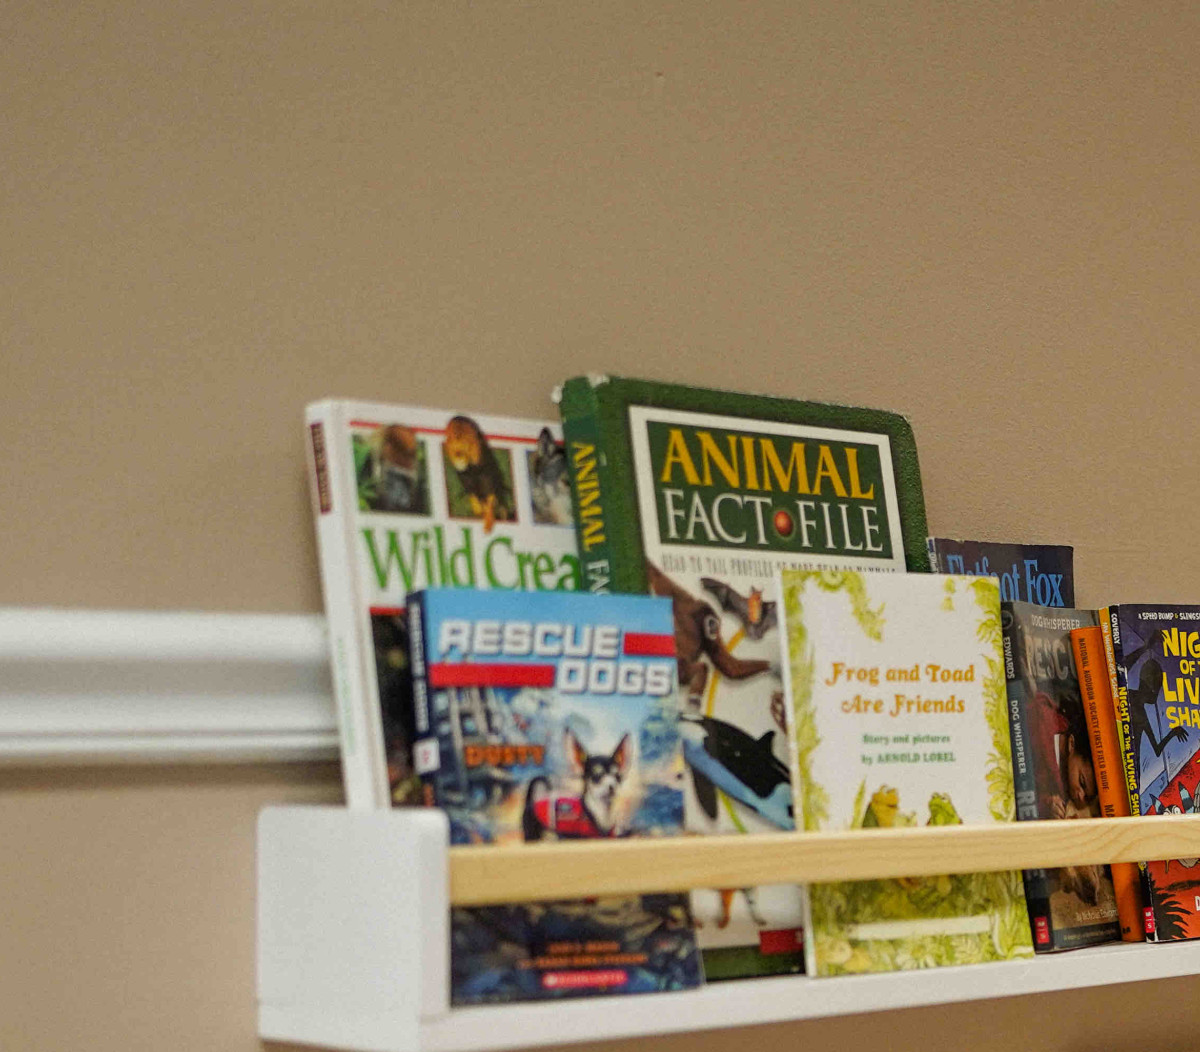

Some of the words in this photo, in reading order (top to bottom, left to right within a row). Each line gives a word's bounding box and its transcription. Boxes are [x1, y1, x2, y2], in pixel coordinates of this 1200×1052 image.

[659, 428, 876, 500] ANIMAL
[572, 440, 606, 552] ANIMAL
[660, 488, 773, 545] FACT
[795, 500, 884, 552] FILE
[361, 526, 474, 591] Wild
[1023, 559, 1065, 608] Fox
[1110, 612, 1121, 645] COVERLY
[1142, 611, 1158, 621] SPEED
[1159, 611, 1174, 621] BUMP
[439, 618, 622, 658] RESCUE
[1078, 637, 1090, 668] NATIONAL
[1003, 636, 1016, 680] EDWARDS
[1180, 659, 1196, 676] OF
[557, 658, 672, 696] DOGS
[825, 662, 880, 687] Frog
[886, 664, 920, 682] and
[925, 664, 975, 682] Toad
[1083, 670, 1095, 700] AUDUBON
[841, 695, 884, 714] Are
[889, 694, 966, 717] Friends
[1011, 700, 1021, 726] DOG
[1089, 701, 1099, 728] SOCIETY
[1118, 686, 1130, 722] NIGHT
[862, 734, 889, 745] Story
[893, 735, 909, 743] and
[913, 733, 950, 746] pictures
[1093, 730, 1102, 749] FIRST
[1124, 724, 1130, 734] OF
[861, 756, 873, 766] by
[877, 753, 920, 763] ARNOLD
[1014, 729, 1027, 774] WHISPERER
[1097, 751, 1107, 771] FIELD
[1126, 752, 1138, 791] LIVING
